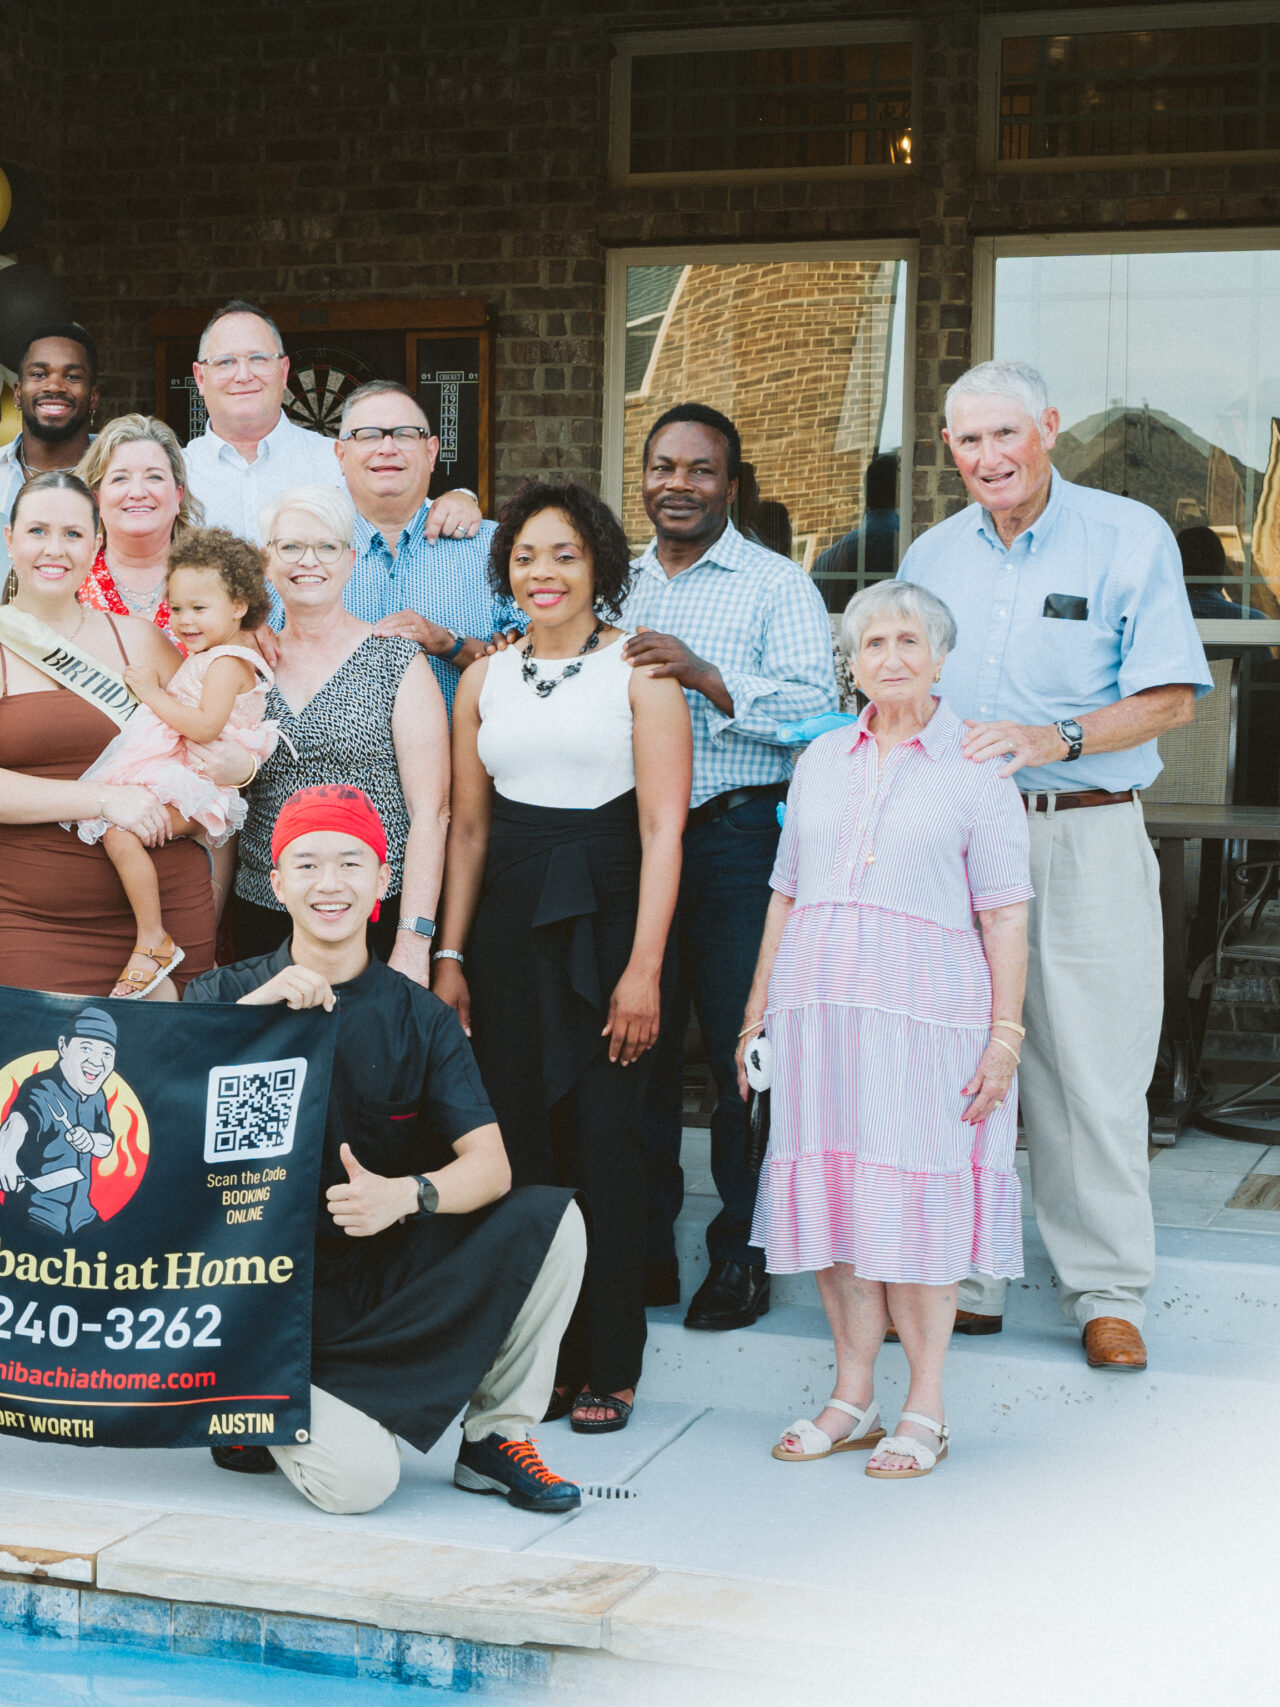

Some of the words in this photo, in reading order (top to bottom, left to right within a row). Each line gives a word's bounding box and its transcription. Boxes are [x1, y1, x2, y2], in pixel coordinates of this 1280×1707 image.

[443, 383, 457, 393] 20
[192, 400, 204, 409] 19
[443, 395, 456, 405] 19
[192, 410, 204, 419] 18
[443, 406, 456, 416] 18
[192, 421, 204, 430] 17
[443, 417, 456, 427] 17
[443, 428, 456, 438] 16
[443, 439, 455, 449] 15
[207, 1173, 237, 1188] Scan
[241, 1170, 260, 1185] the
[262, 1166, 287, 1182] Code
[222, 1186, 270, 1206] BOOKING
[226, 1205, 264, 1225] ONLINE
[113, 1256, 159, 1291] at
[162, 1251, 294, 1290] Home
[28, 1415, 94, 1438] WORTH
[208, 1413, 274, 1435] AUSTIN
